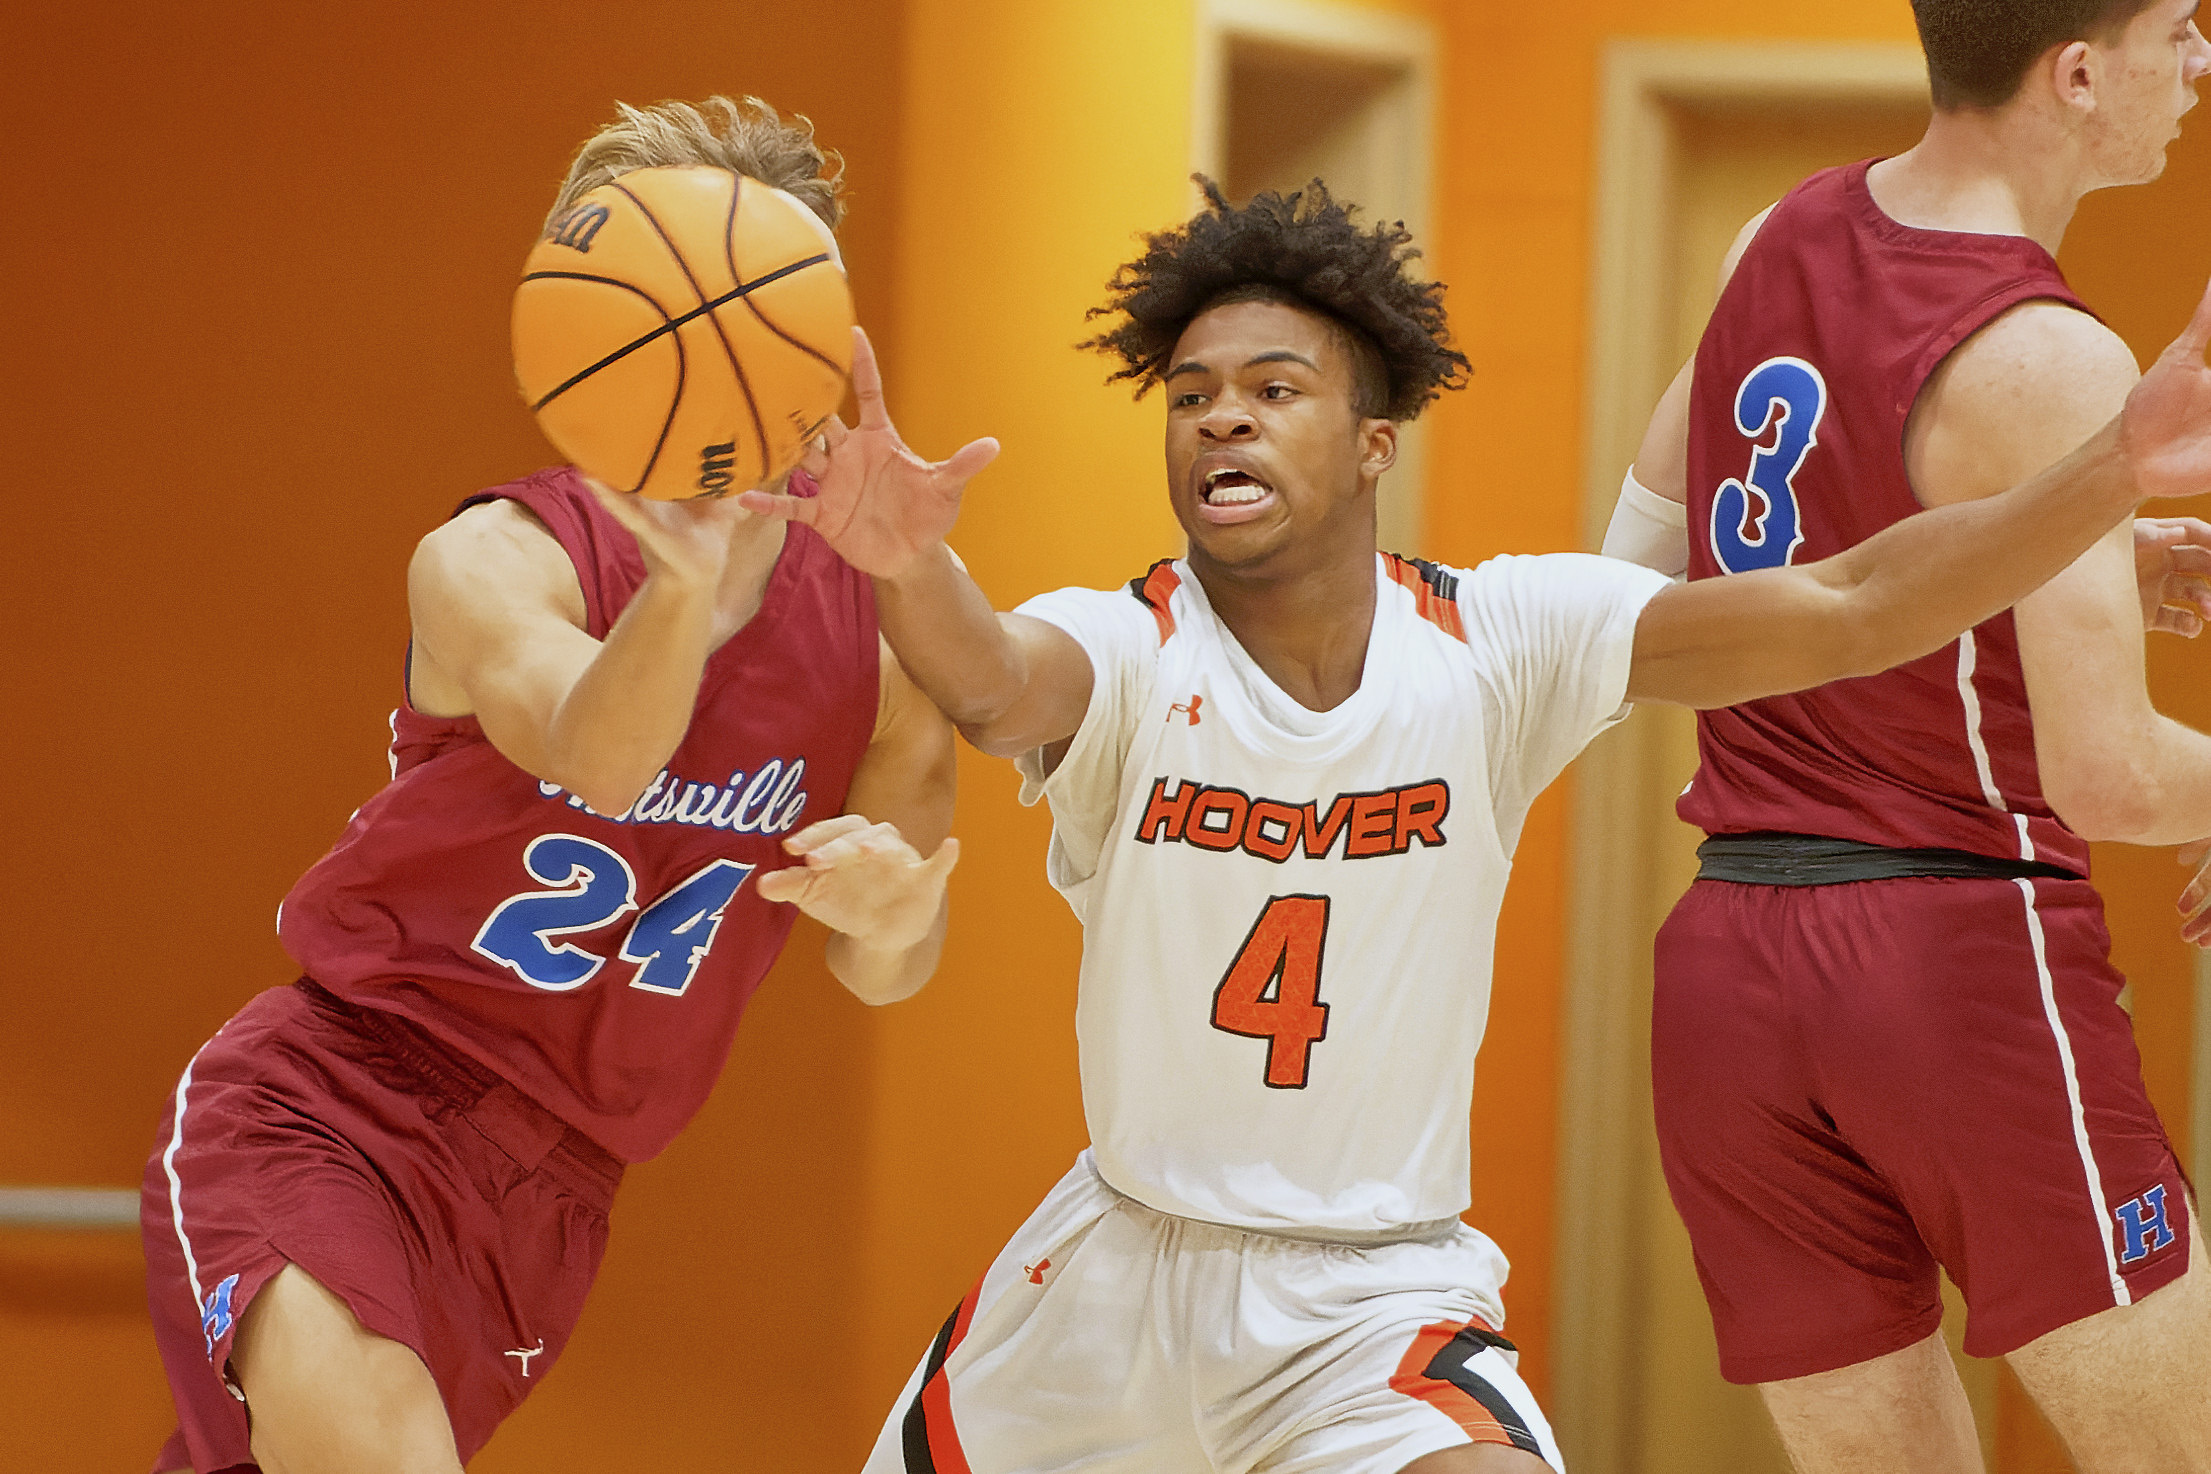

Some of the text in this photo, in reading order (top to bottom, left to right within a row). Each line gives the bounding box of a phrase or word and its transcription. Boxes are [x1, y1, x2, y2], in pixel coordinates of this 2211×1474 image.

[1710, 356, 1827, 575] 3
[538, 756, 808, 836] tsville
[1135, 777, 1451, 864] HOOVER
[470, 833, 756, 996] 24
[1210, 892, 1331, 1090] 4
[2114, 1183, 2176, 1264] H
